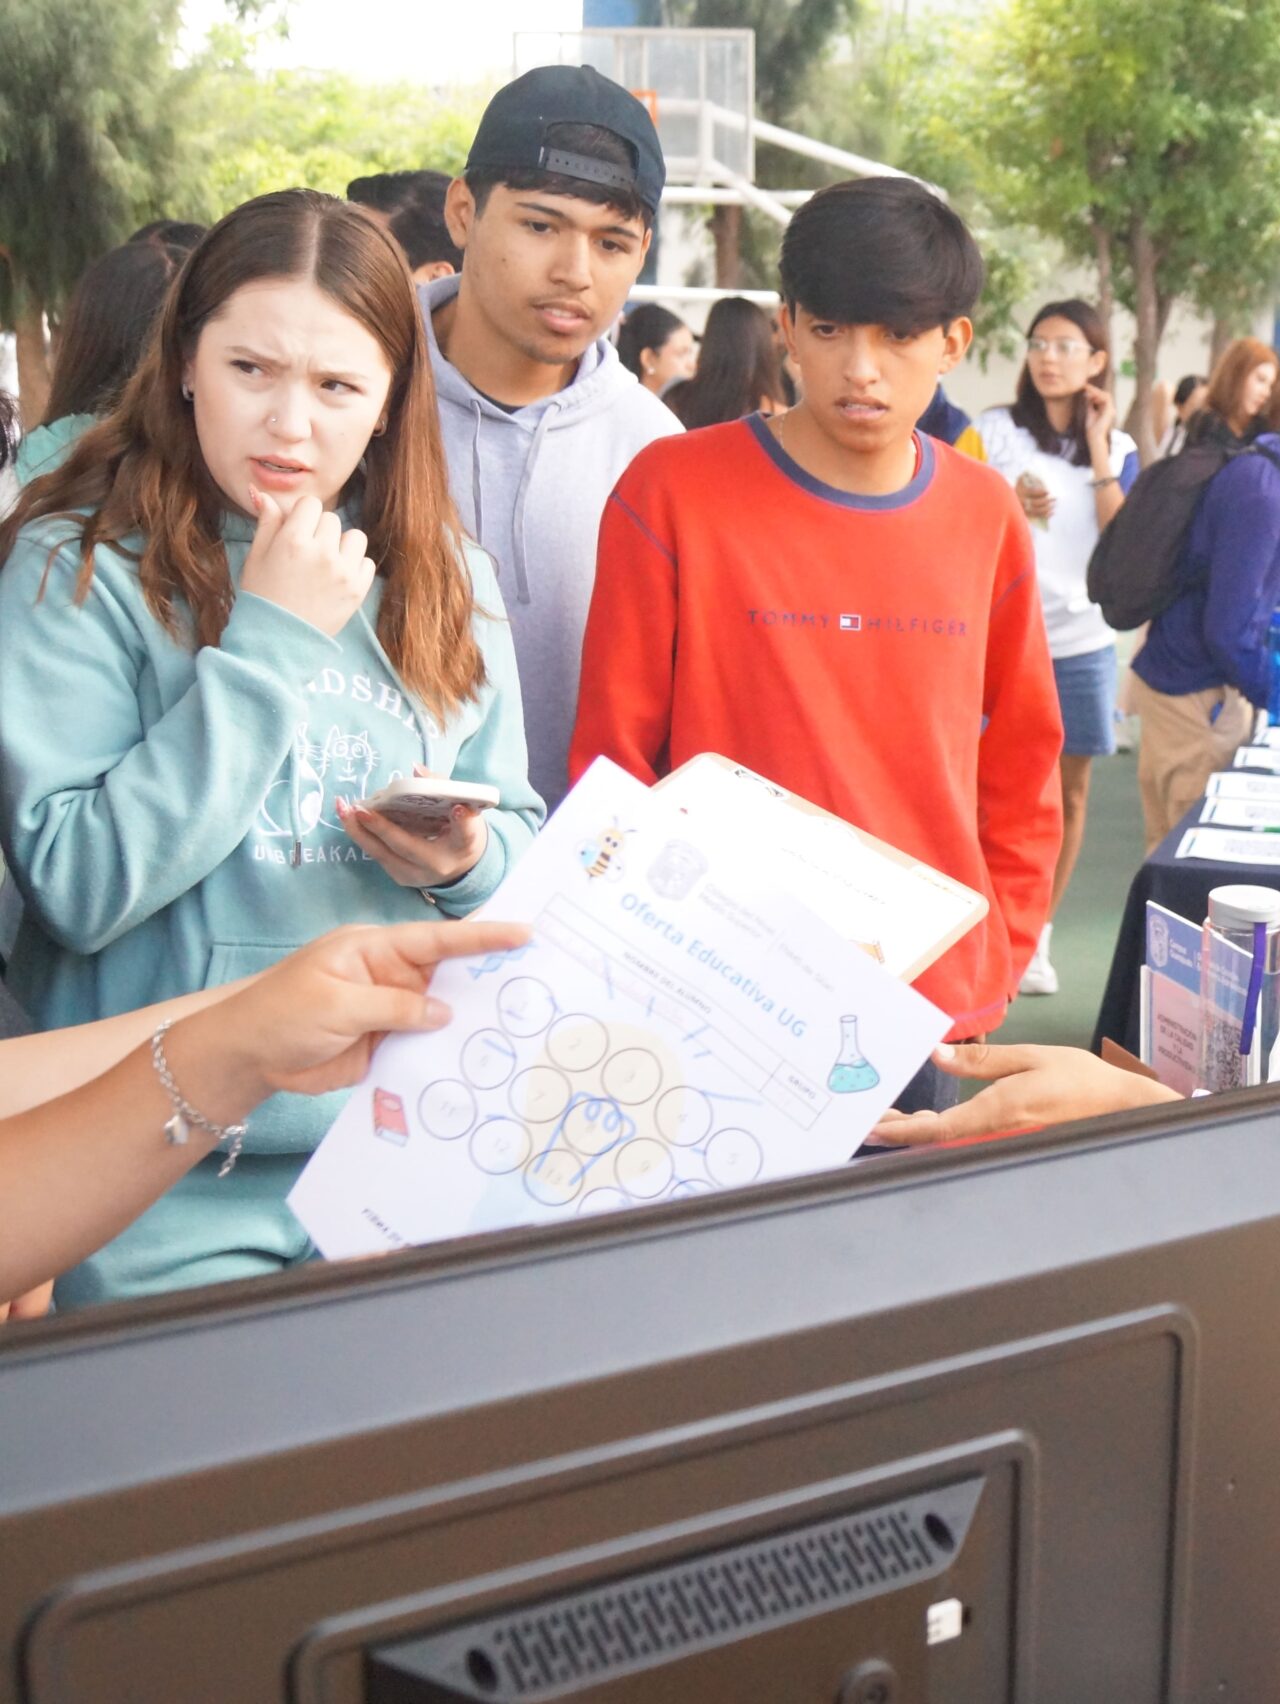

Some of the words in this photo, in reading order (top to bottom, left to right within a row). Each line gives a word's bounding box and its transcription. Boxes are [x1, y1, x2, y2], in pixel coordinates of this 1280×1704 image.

[748, 611, 829, 629] TOMMY
[867, 617, 967, 635] HILFIGER
[306, 668, 438, 738] DSH
[620, 892, 685, 946] Oferta
[686, 938, 776, 1013] Educativa
[776, 1007, 808, 1038] UG
[623, 951, 659, 977] NOMBRE
[660, 975, 676, 992] DEL
[676, 987, 713, 1015] ALUMNO
[788, 1074, 817, 1101] GRUPO
